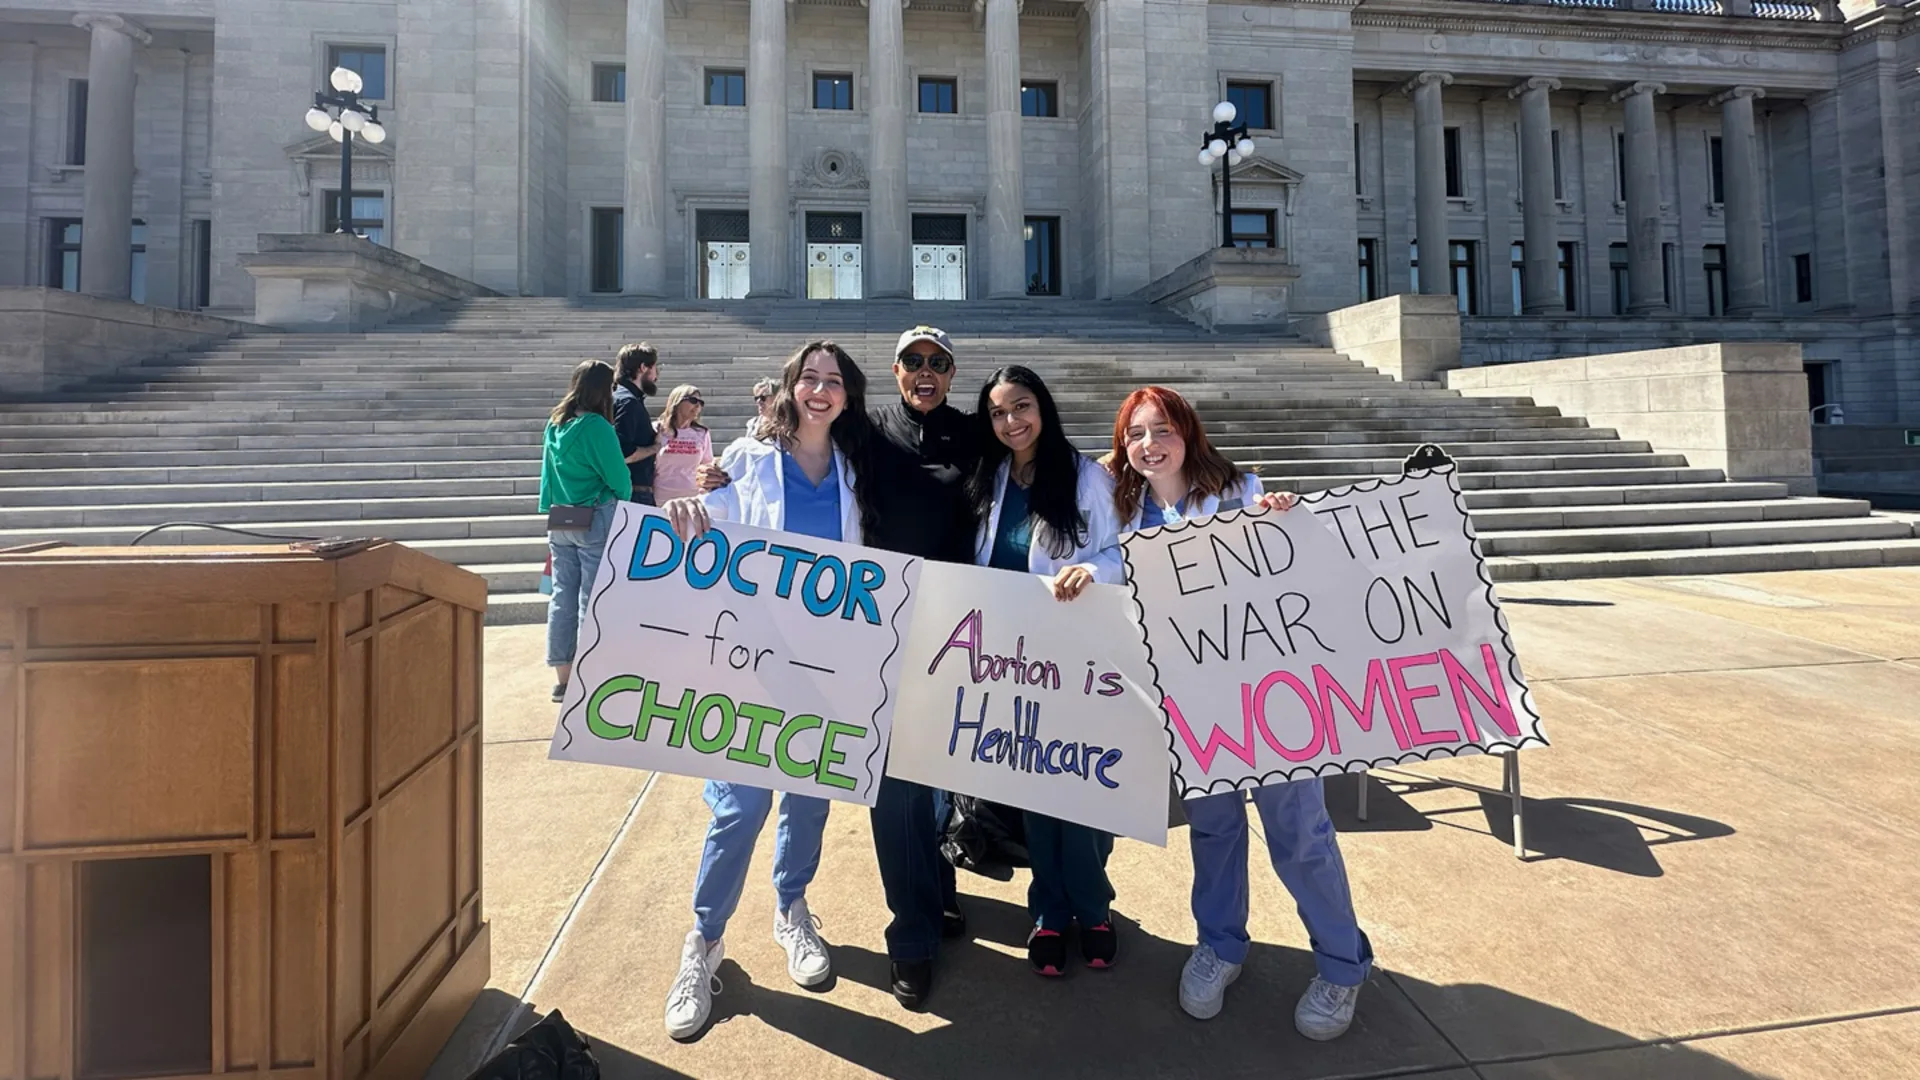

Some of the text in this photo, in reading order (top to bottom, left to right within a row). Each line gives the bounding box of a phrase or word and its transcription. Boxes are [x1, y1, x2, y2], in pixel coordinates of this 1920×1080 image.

[627, 514, 886, 625] DOCTOR
[1168, 490, 1440, 595] END THE
[705, 610, 774, 672] for
[928, 609, 1124, 696] Abortion is
[1168, 571, 1452, 664] WAR ON
[586, 674, 867, 790] CHOICE
[948, 686, 1123, 789] Healthcare
[1163, 643, 1521, 775] WOMEN
